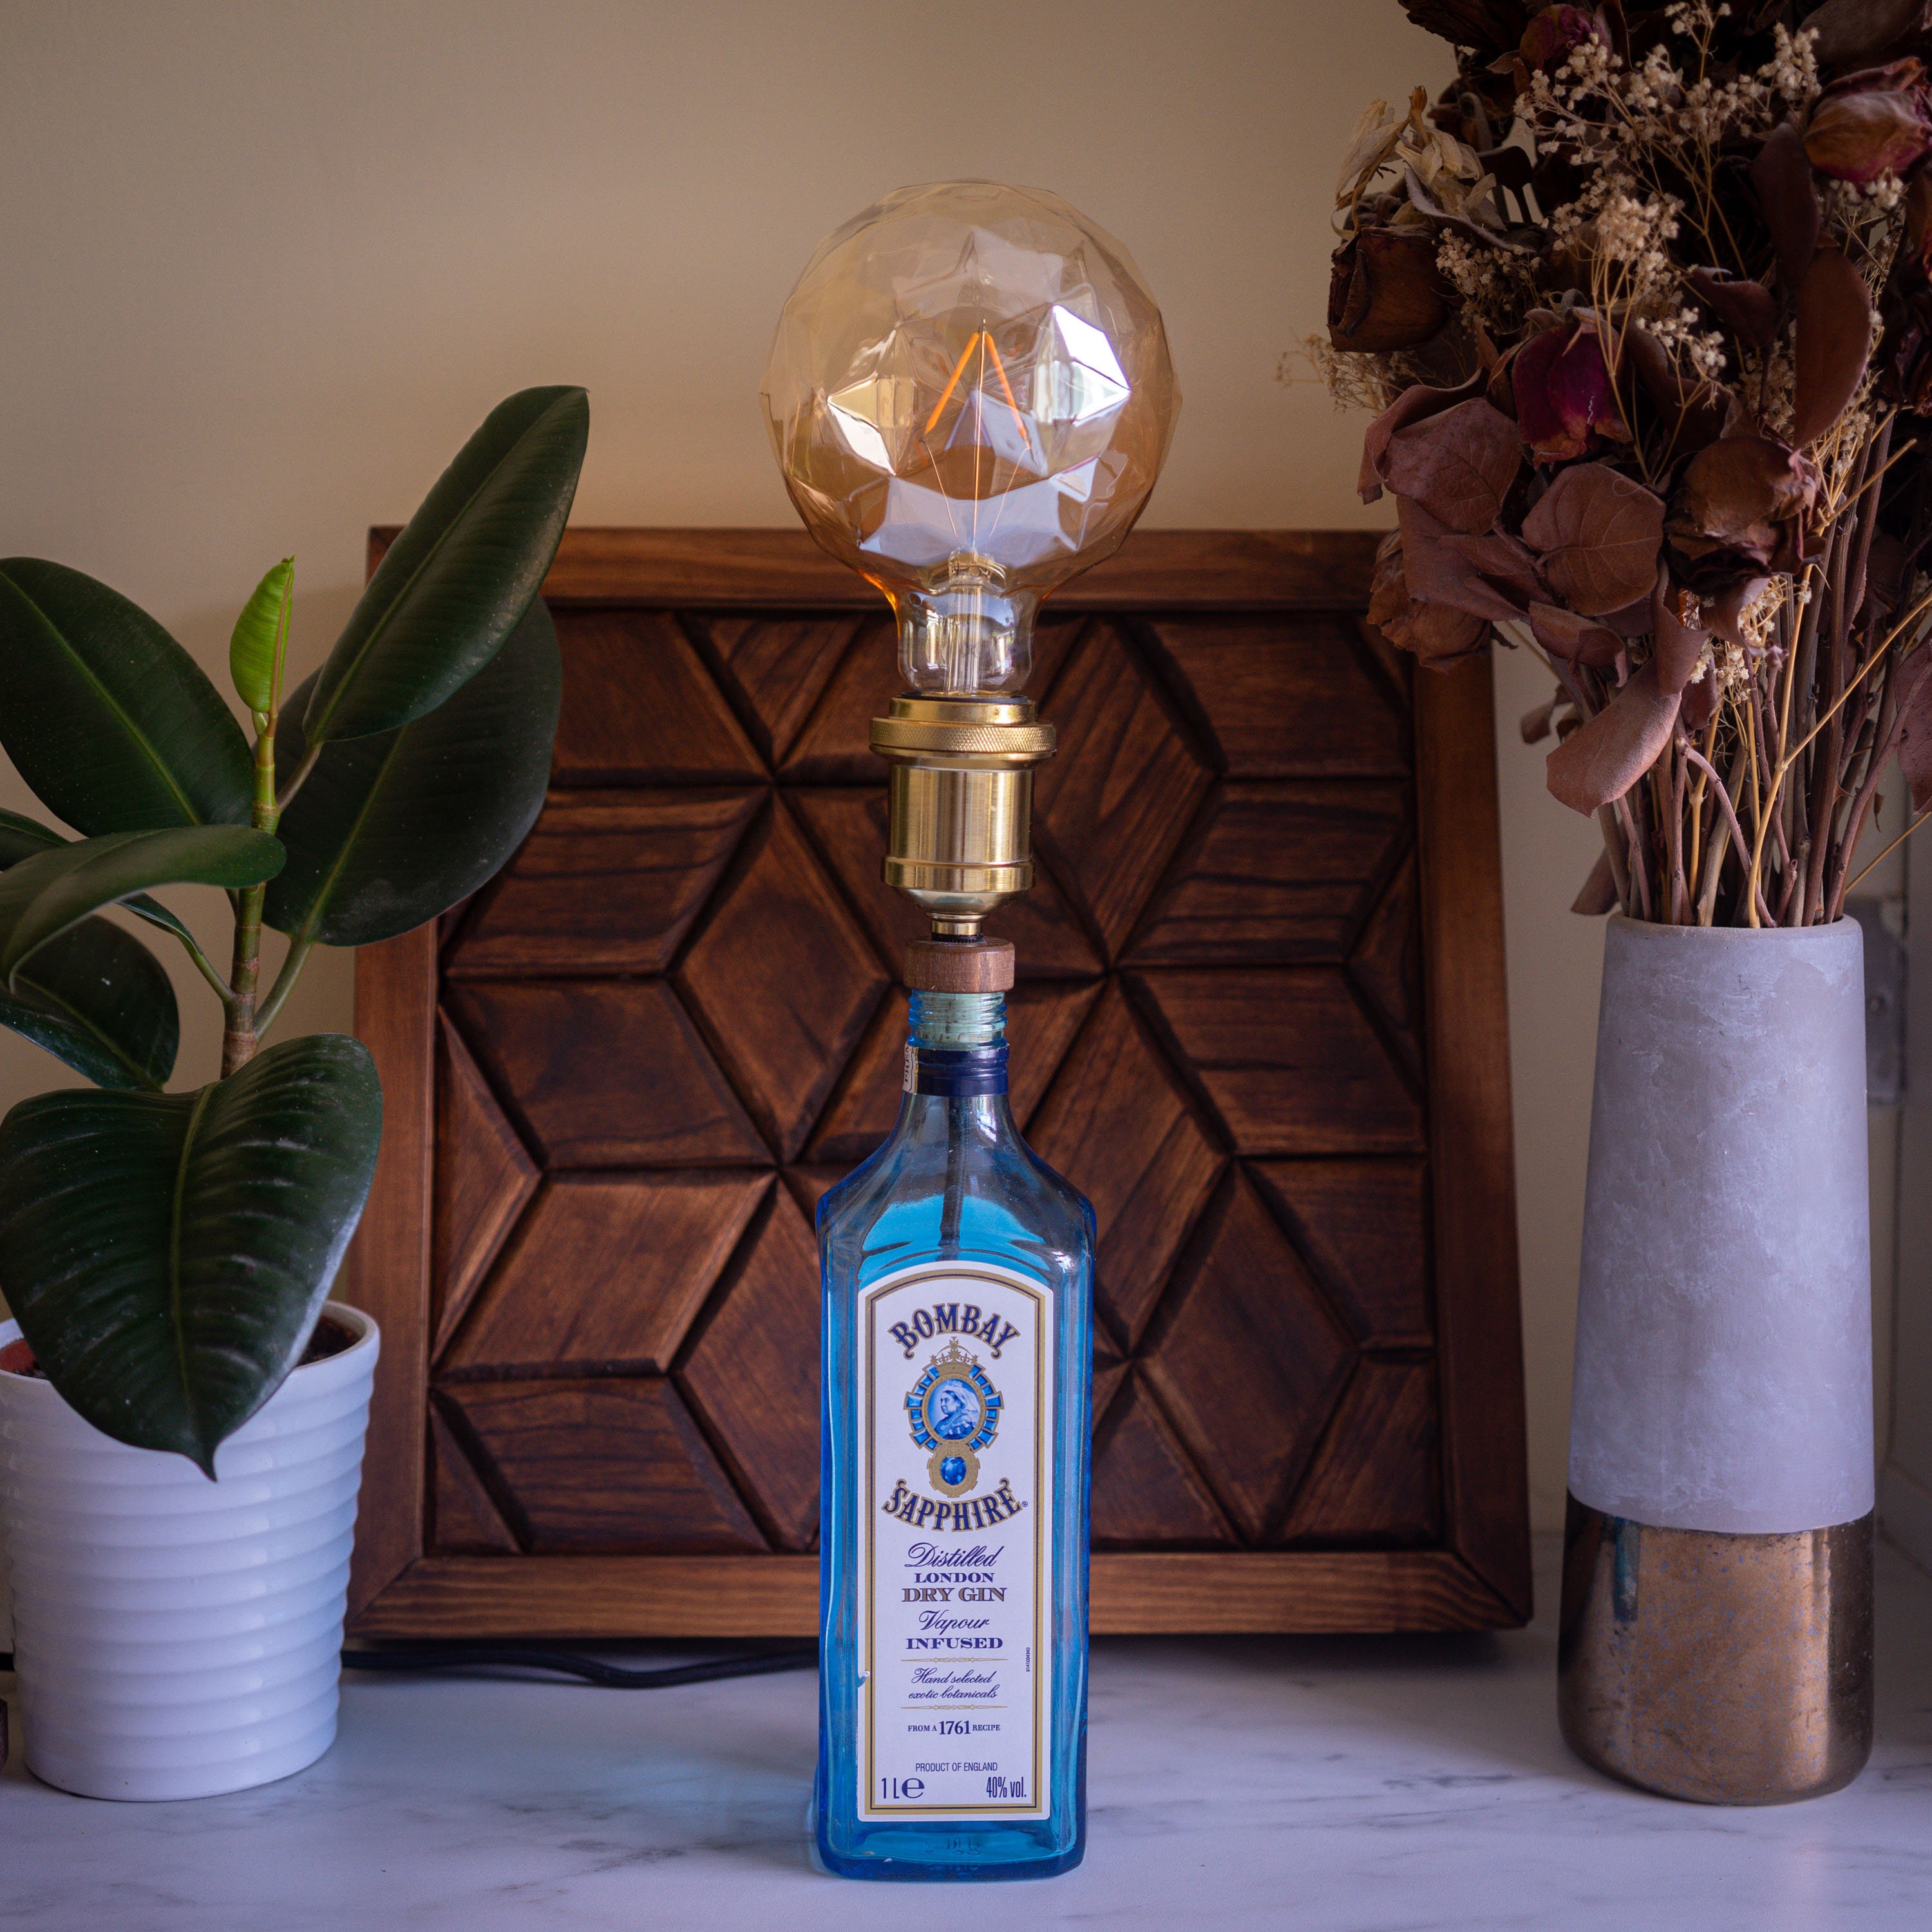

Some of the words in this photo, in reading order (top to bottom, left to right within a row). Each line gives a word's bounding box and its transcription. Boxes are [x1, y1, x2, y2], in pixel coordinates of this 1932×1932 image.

[888, 1302, 1021, 1360] BOMBAY
[904, 1542, 1005, 1567] Distilled
[914, 1572, 995, 1583] LONDON
[902, 1587, 955, 1602] DRY
[958, 1587, 1007, 1602] GIN
[919, 1609, 990, 1635] Vapour
[905, 1637, 1003, 1649] INFUSED
[911, 1667, 954, 1684] Hand
[951, 1669, 997, 1683] selected
[908, 1689, 938, 1699] exotic
[940, 1684, 999, 1699] botanicals
[939, 1720, 971, 1735] 1761
[915, 1763, 950, 1772] PRODUCT
[952, 1763, 961, 1772] OF
[963, 1762, 998, 1771] ENGLAND
[986, 1776, 1007, 1798] 40%
[1010, 1776, 1027, 1797] vol.
